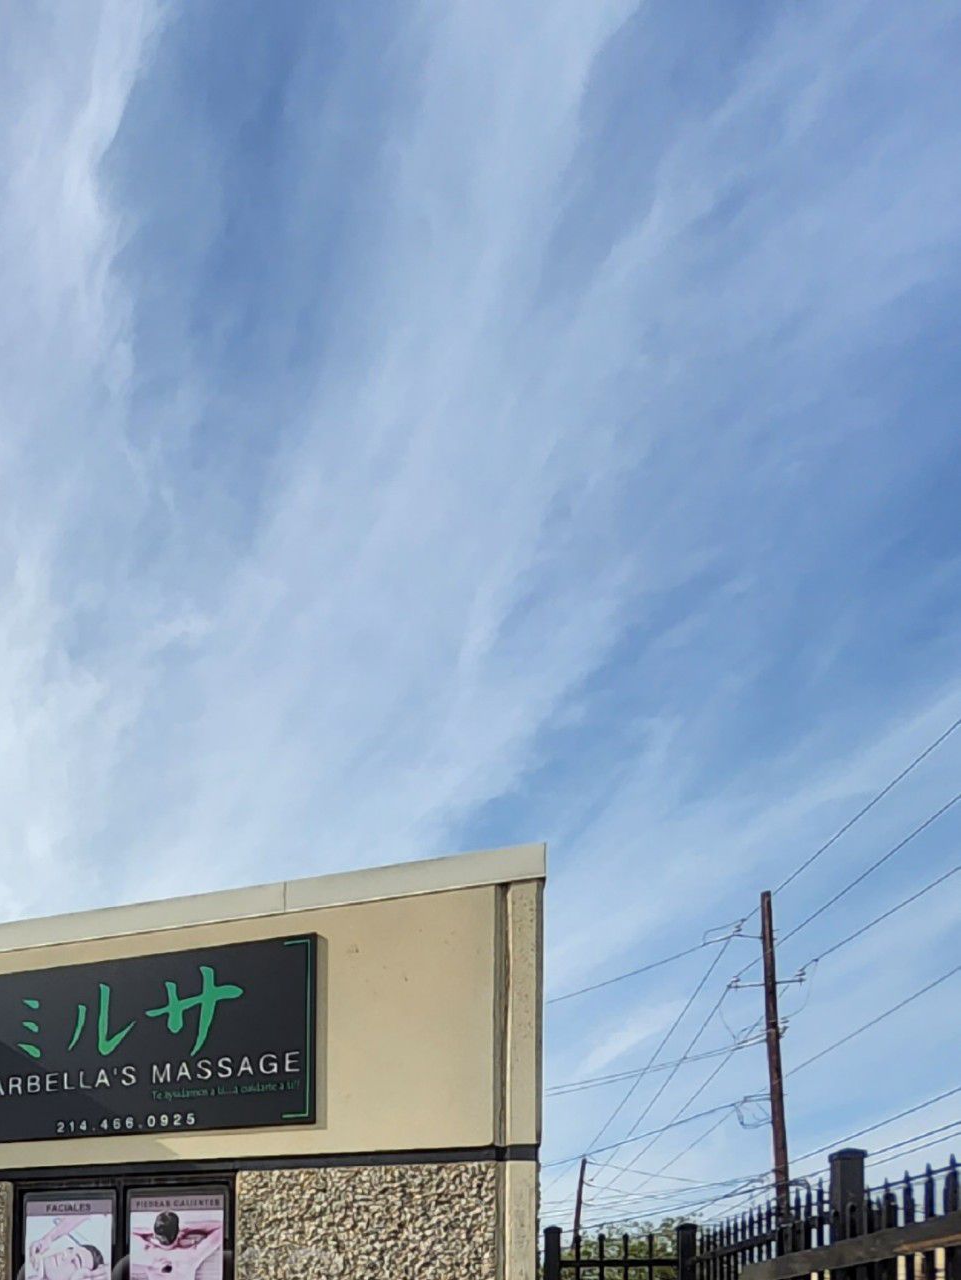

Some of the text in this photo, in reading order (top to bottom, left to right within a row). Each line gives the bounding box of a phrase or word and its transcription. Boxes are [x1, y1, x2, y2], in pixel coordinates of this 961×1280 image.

[17, 966, 244, 1058] ミルサ
[152, 1051, 301, 1085] MASSAGE
[56, 1113, 196, 1134] 214.466.0925
[45, 1202, 92, 1213] FACIALES
